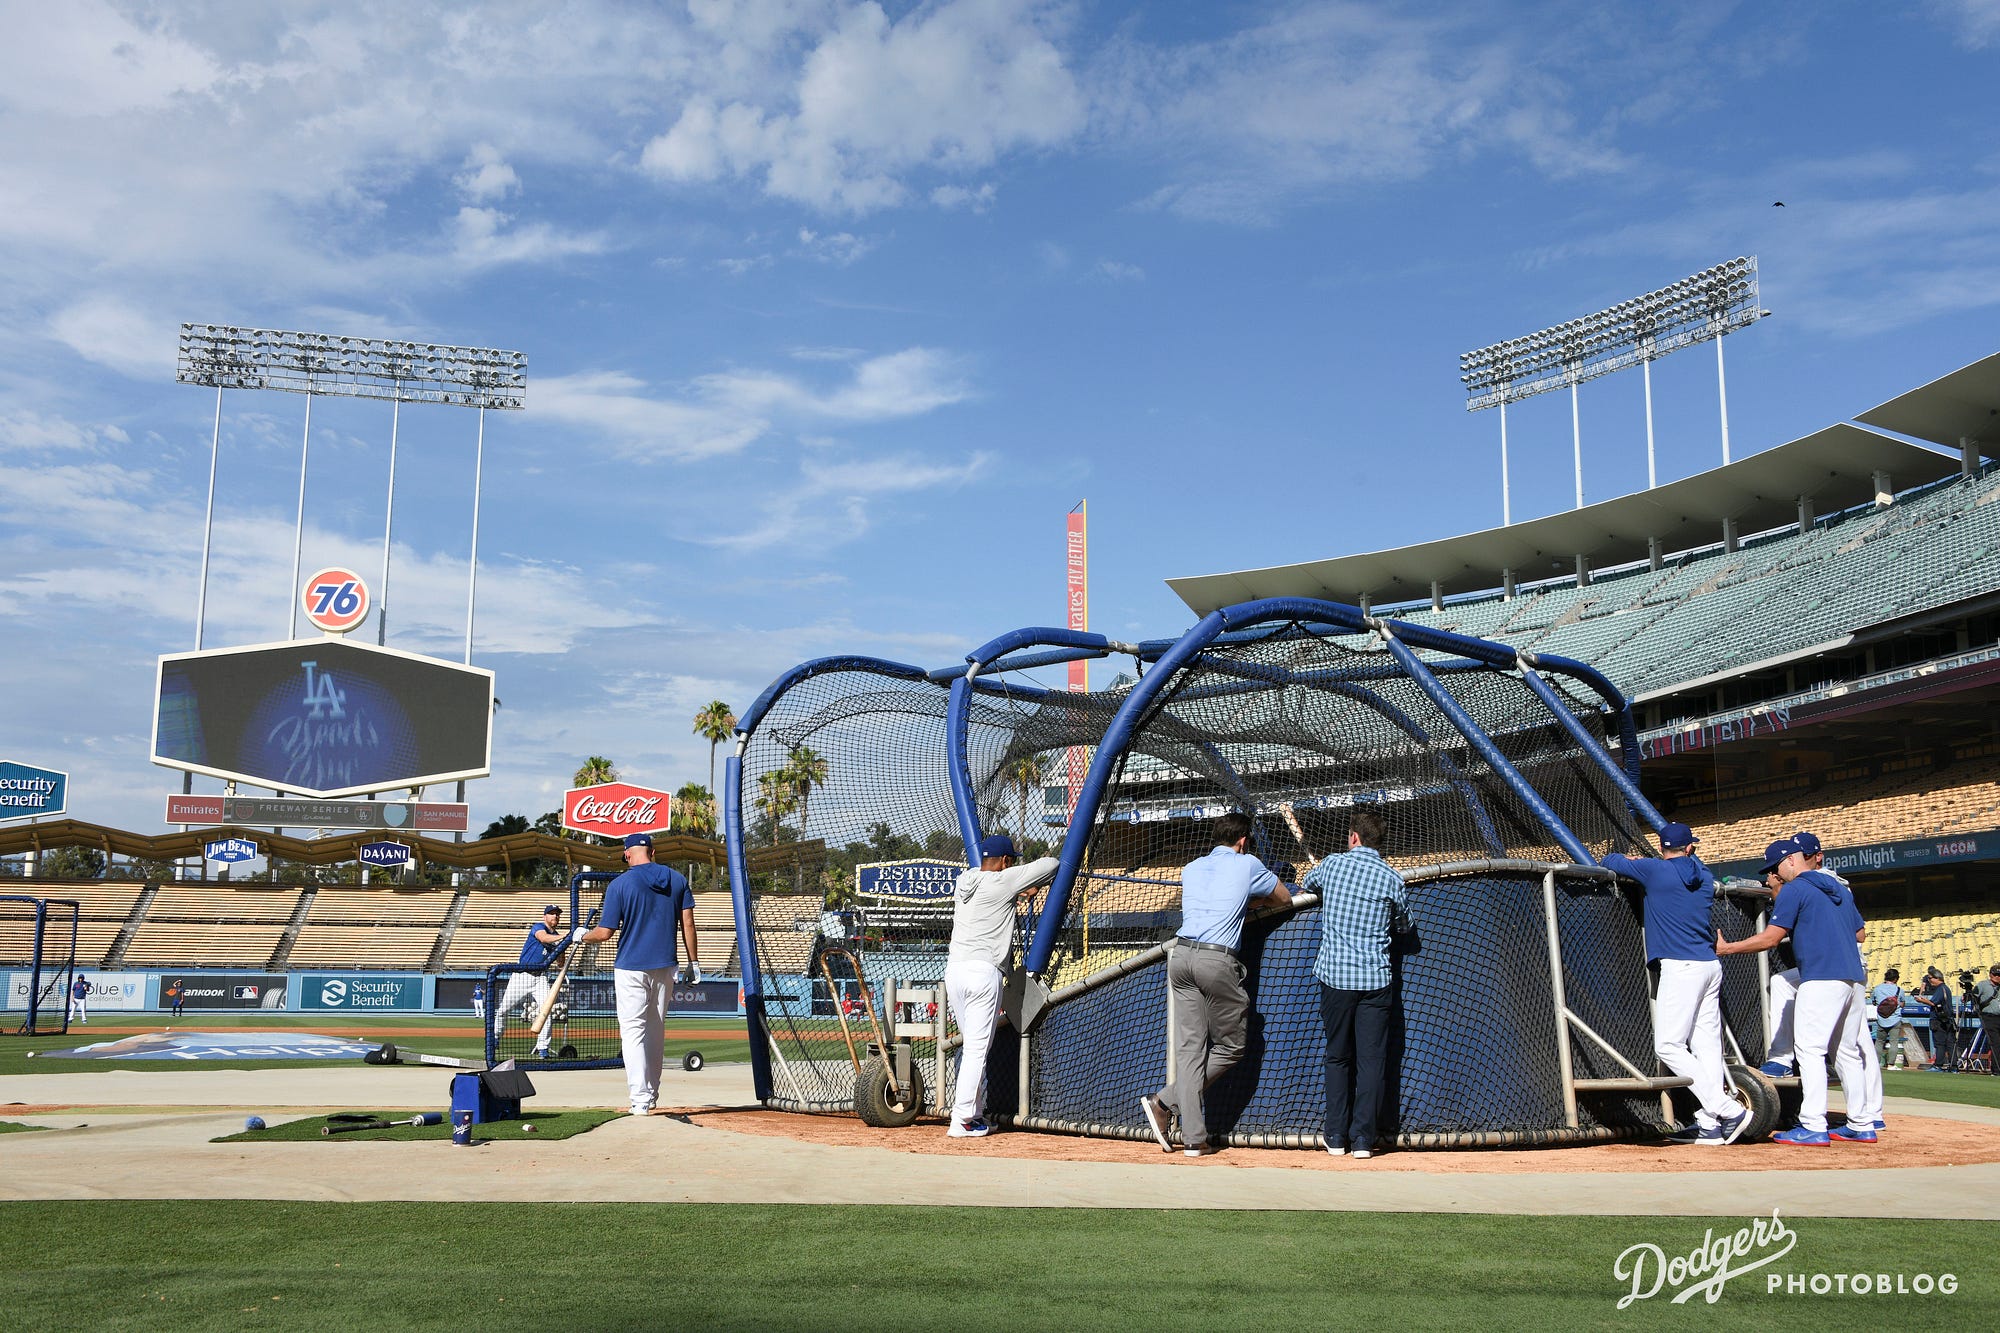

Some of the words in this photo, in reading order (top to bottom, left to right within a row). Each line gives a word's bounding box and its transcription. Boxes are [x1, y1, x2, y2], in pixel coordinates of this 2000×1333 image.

[1069, 531, 1083, 566] BETTER
[1069, 568, 1083, 585] FLY
[311, 580, 361, 617] 76
[1070, 590, 1083, 631] rates
[301, 661, 347, 720] LA
[0, 777, 56, 794] ecurity
[0, 792, 46, 807] enefit
[172, 804, 220, 815] Emirates
[260, 804, 308, 813] FREEWAY
[312, 805, 349, 814] SERIES
[572, 794, 663, 824] Coca-Cola
[207, 842, 226, 858] JIM
[228, 839, 254, 859] BEAM
[363, 847, 406, 860] DASANI
[1936, 841, 1977, 857] TACOM
[1822, 853, 1857, 871] Japan
[1859, 847, 1896, 868] Night
[878, 866, 967, 881] ESTREL
[869, 880, 955, 895] JALISCO
[17, 982, 54, 996] be
[351, 980, 403, 995] Security
[351, 994, 398, 1006] Benefit
[171, 1045, 380, 1060] Helpf
